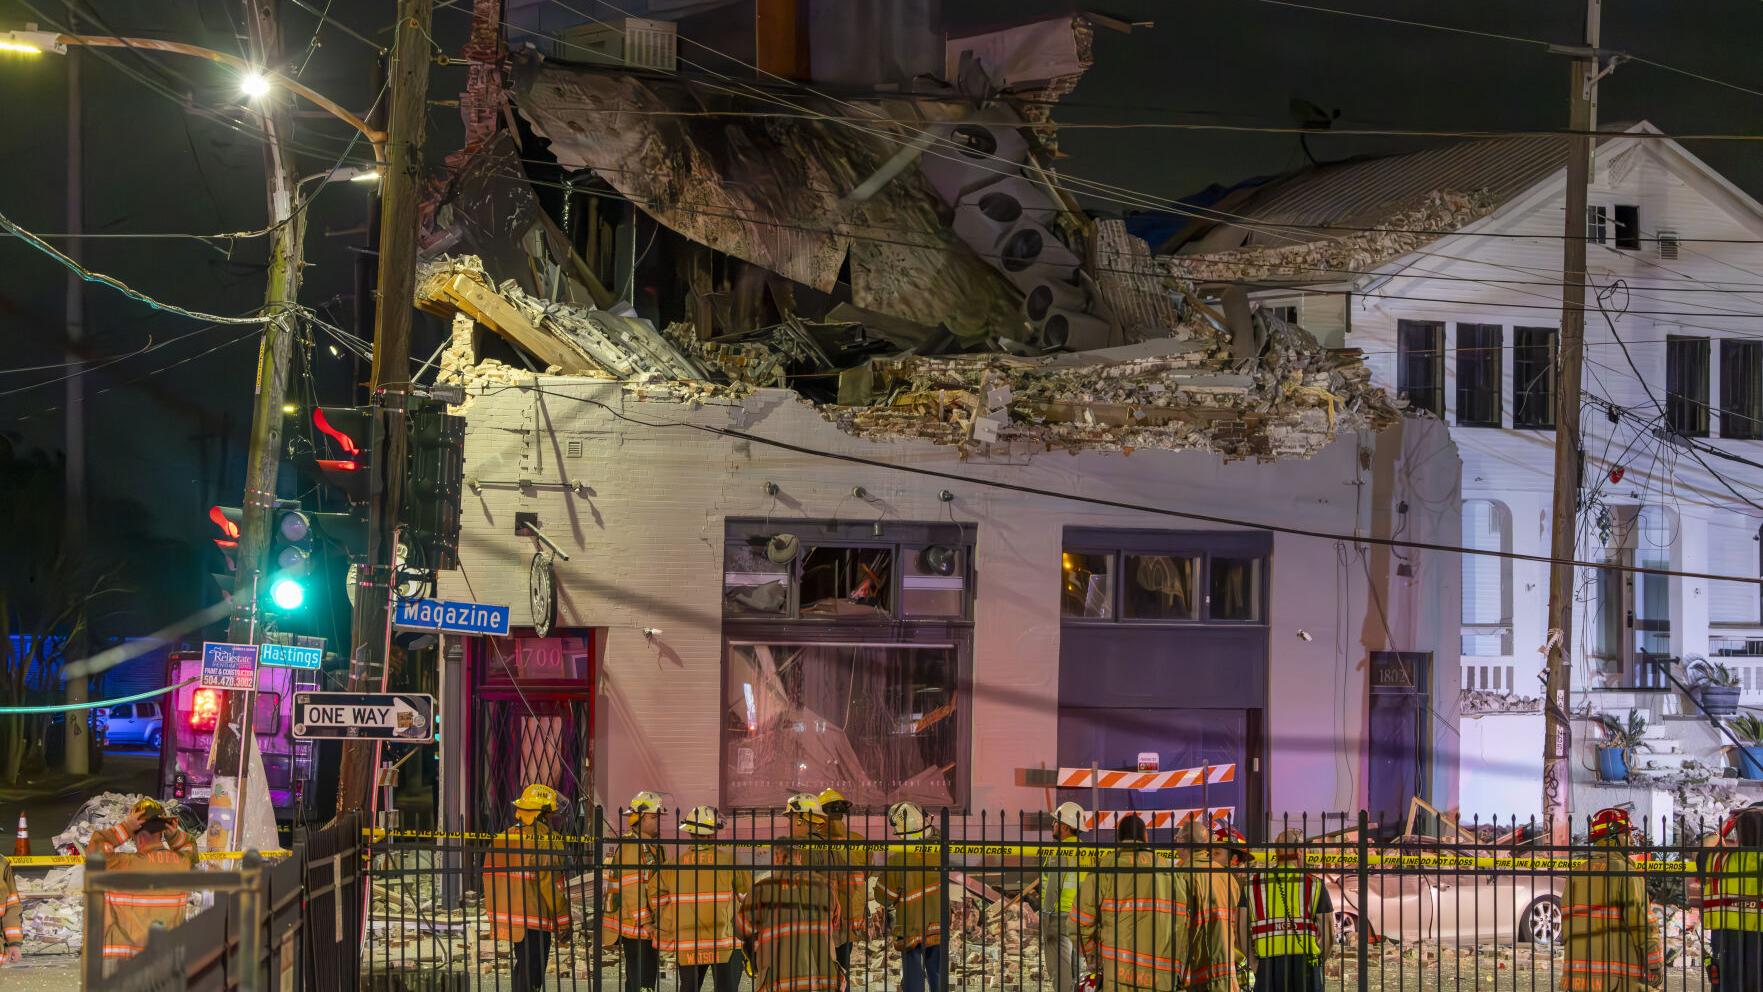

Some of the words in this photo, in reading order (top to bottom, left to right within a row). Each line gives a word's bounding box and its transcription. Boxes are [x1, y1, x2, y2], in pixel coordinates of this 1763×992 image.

[403, 601, 501, 628] Magazine
[263, 645, 319, 666] Hastings
[204, 667, 218, 675] PAINT
[308, 707, 345, 724] ONE
[352, 707, 390, 725] WAY
[914, 845, 933, 853] FIRE
[953, 846, 966, 854] DO
[967, 847, 985, 855] NOT
[986, 847, 1012, 855] CROSS
[1402, 857, 1420, 865] LINE
